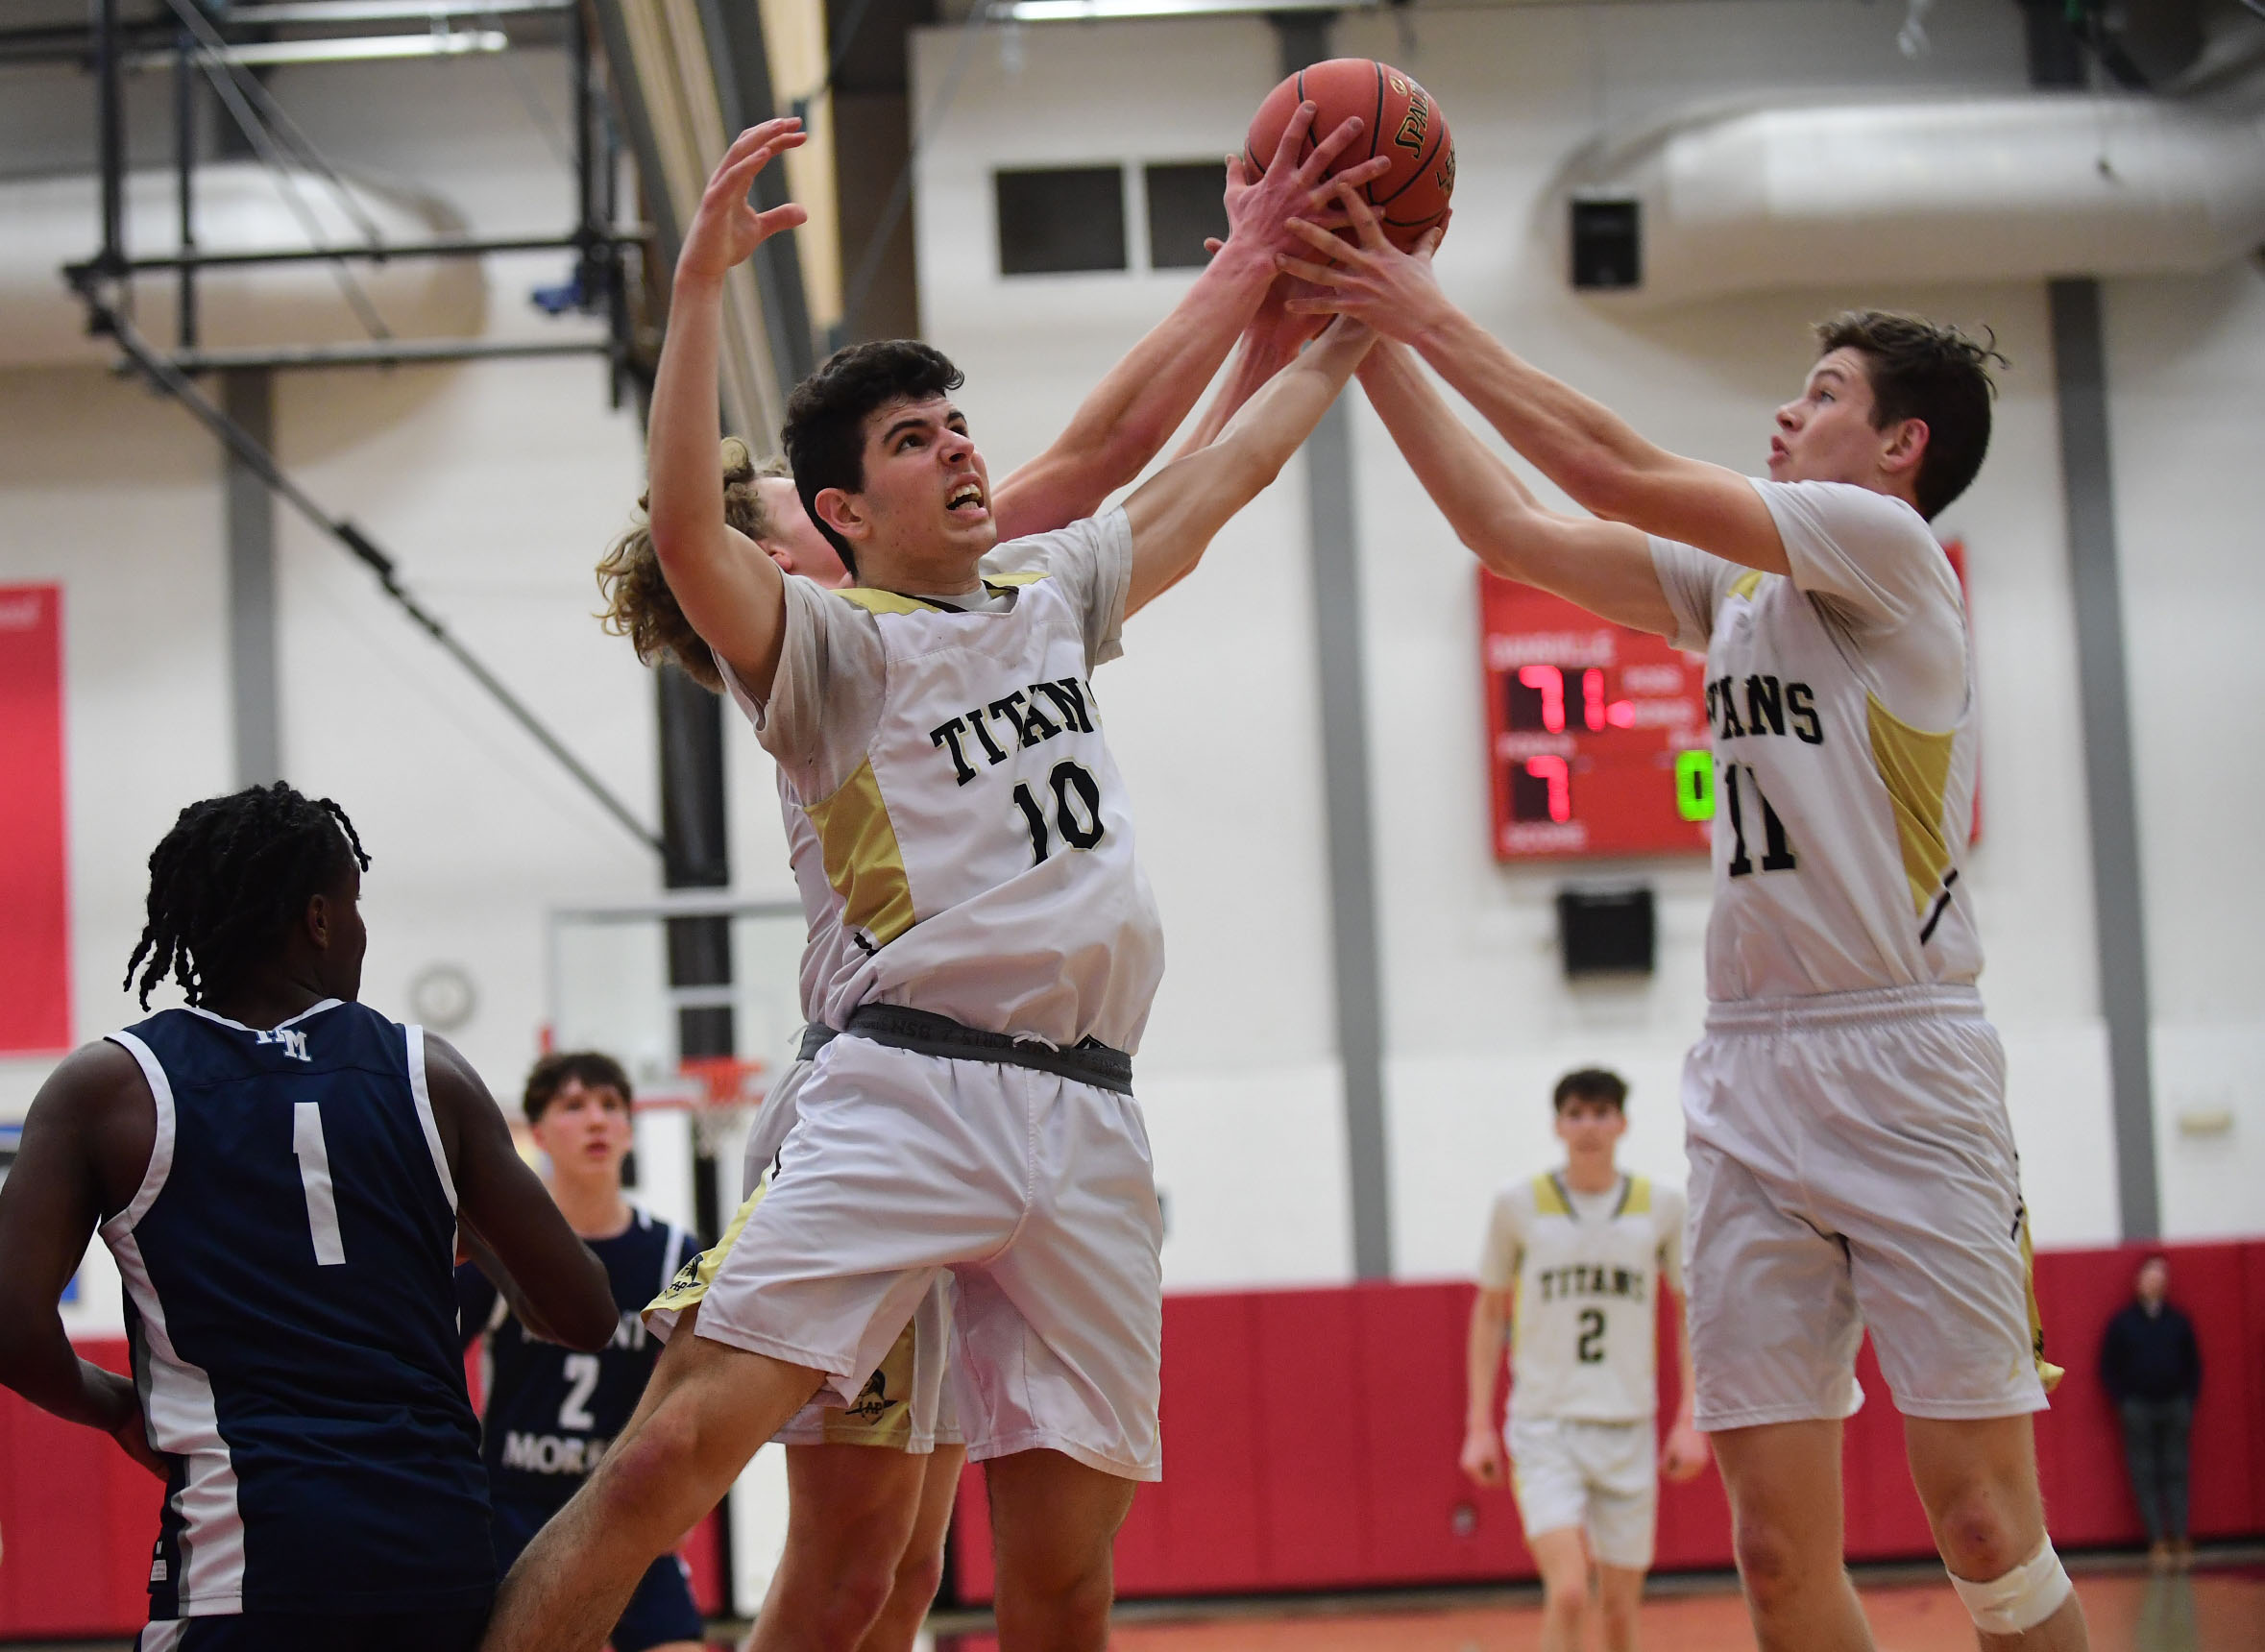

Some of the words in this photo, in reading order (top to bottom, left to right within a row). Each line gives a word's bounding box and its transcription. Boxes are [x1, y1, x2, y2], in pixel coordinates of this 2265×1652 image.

[1011, 757, 1105, 868] 10
[1526, 755, 1571, 823] 7
[1724, 764, 1796, 877] 11
[292, 1101, 347, 1266] 1
[1576, 1307, 1607, 1364] 2
[558, 1352, 602, 1431] 2
